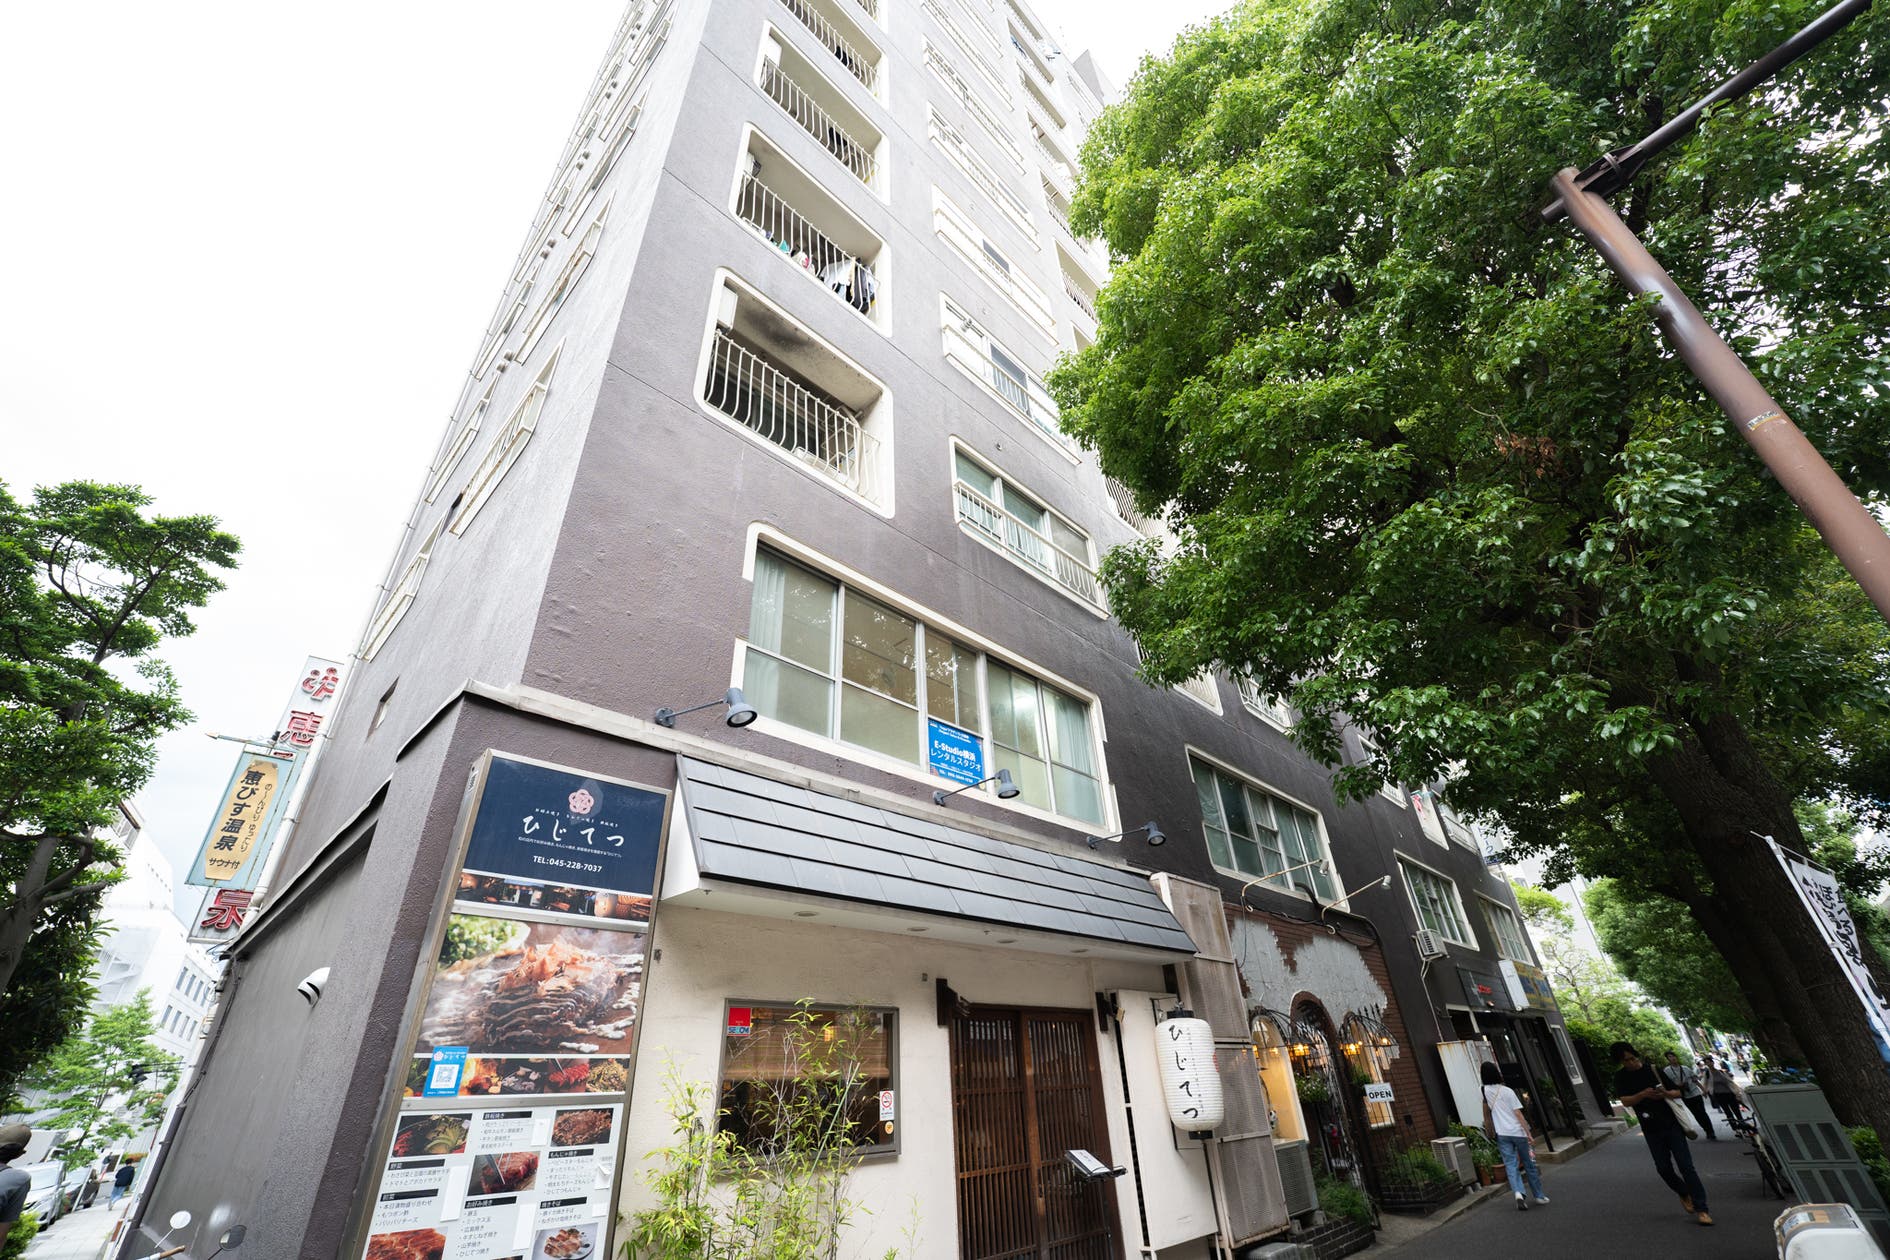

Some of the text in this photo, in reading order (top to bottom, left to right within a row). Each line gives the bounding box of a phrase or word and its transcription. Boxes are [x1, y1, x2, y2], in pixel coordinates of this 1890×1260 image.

[213, 770, 266, 853] 恵びす温泉
[522, 815, 625, 847] ひじてつ
[209, 857, 240, 870] サウナ付
[533, 855, 603, 873] TEL:045-228-7037
[1168, 1024, 1199, 1119] ひじてつ
[1368, 1090, 1392, 1099] OPEN
